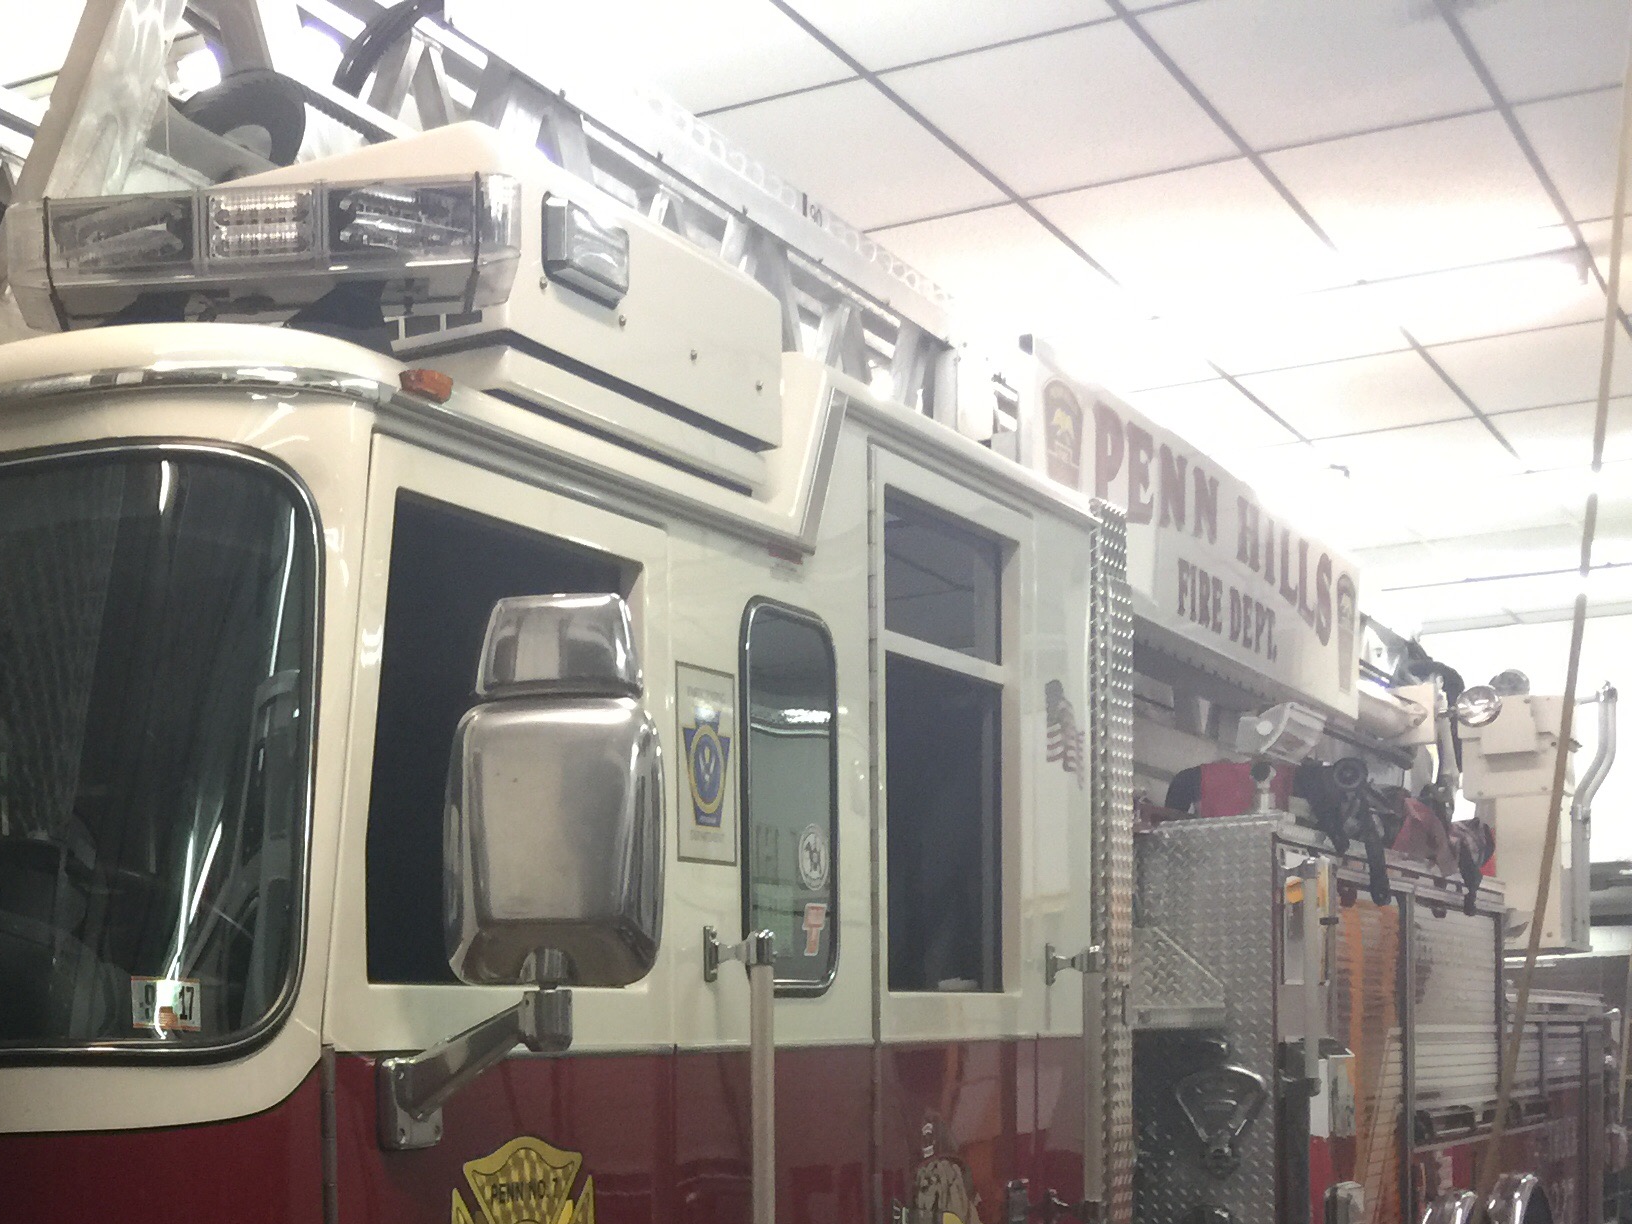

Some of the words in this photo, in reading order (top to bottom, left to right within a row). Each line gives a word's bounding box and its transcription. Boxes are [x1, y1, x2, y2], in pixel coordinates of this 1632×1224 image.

[1093, 398, 1219, 545] PENN
[1236, 494, 1334, 647] HILLS
[1177, 557, 1223, 635] FIRE
[179, 986, 195, 1021] 17
